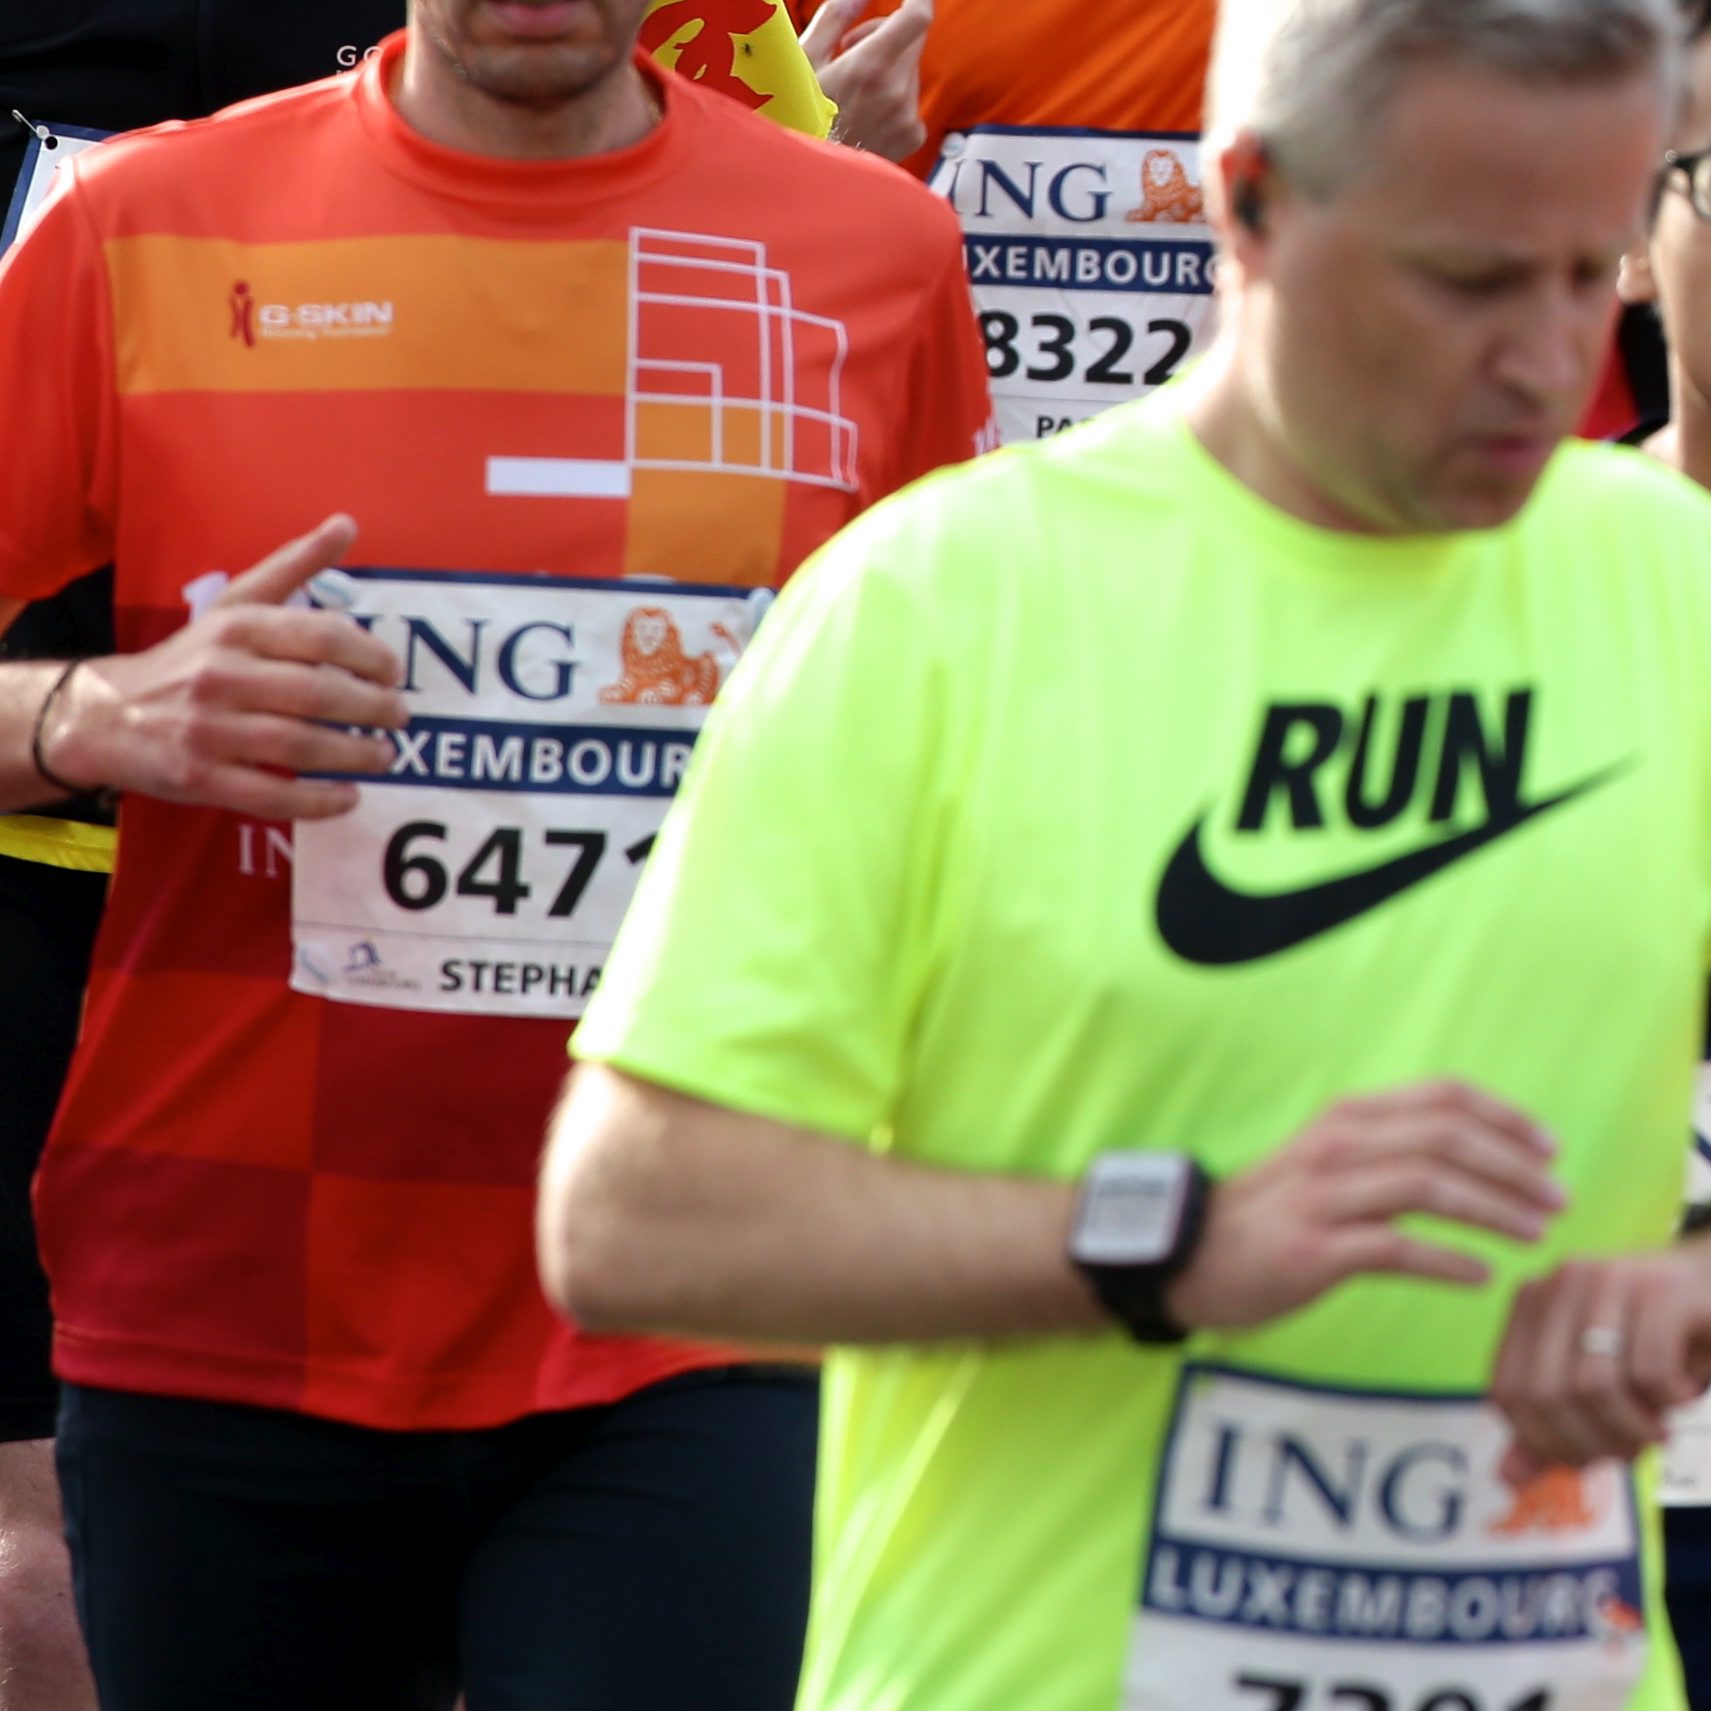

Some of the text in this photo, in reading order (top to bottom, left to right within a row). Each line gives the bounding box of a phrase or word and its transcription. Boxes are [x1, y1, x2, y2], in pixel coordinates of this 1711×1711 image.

[961, 243, 1219, 287] XEMBOUR
[978, 309, 1193, 387] 8322
[349, 726, 694, 787] XEMBOUR
[1234, 687, 1535, 835] RUN
[1202, 1423, 1471, 1544] ING
